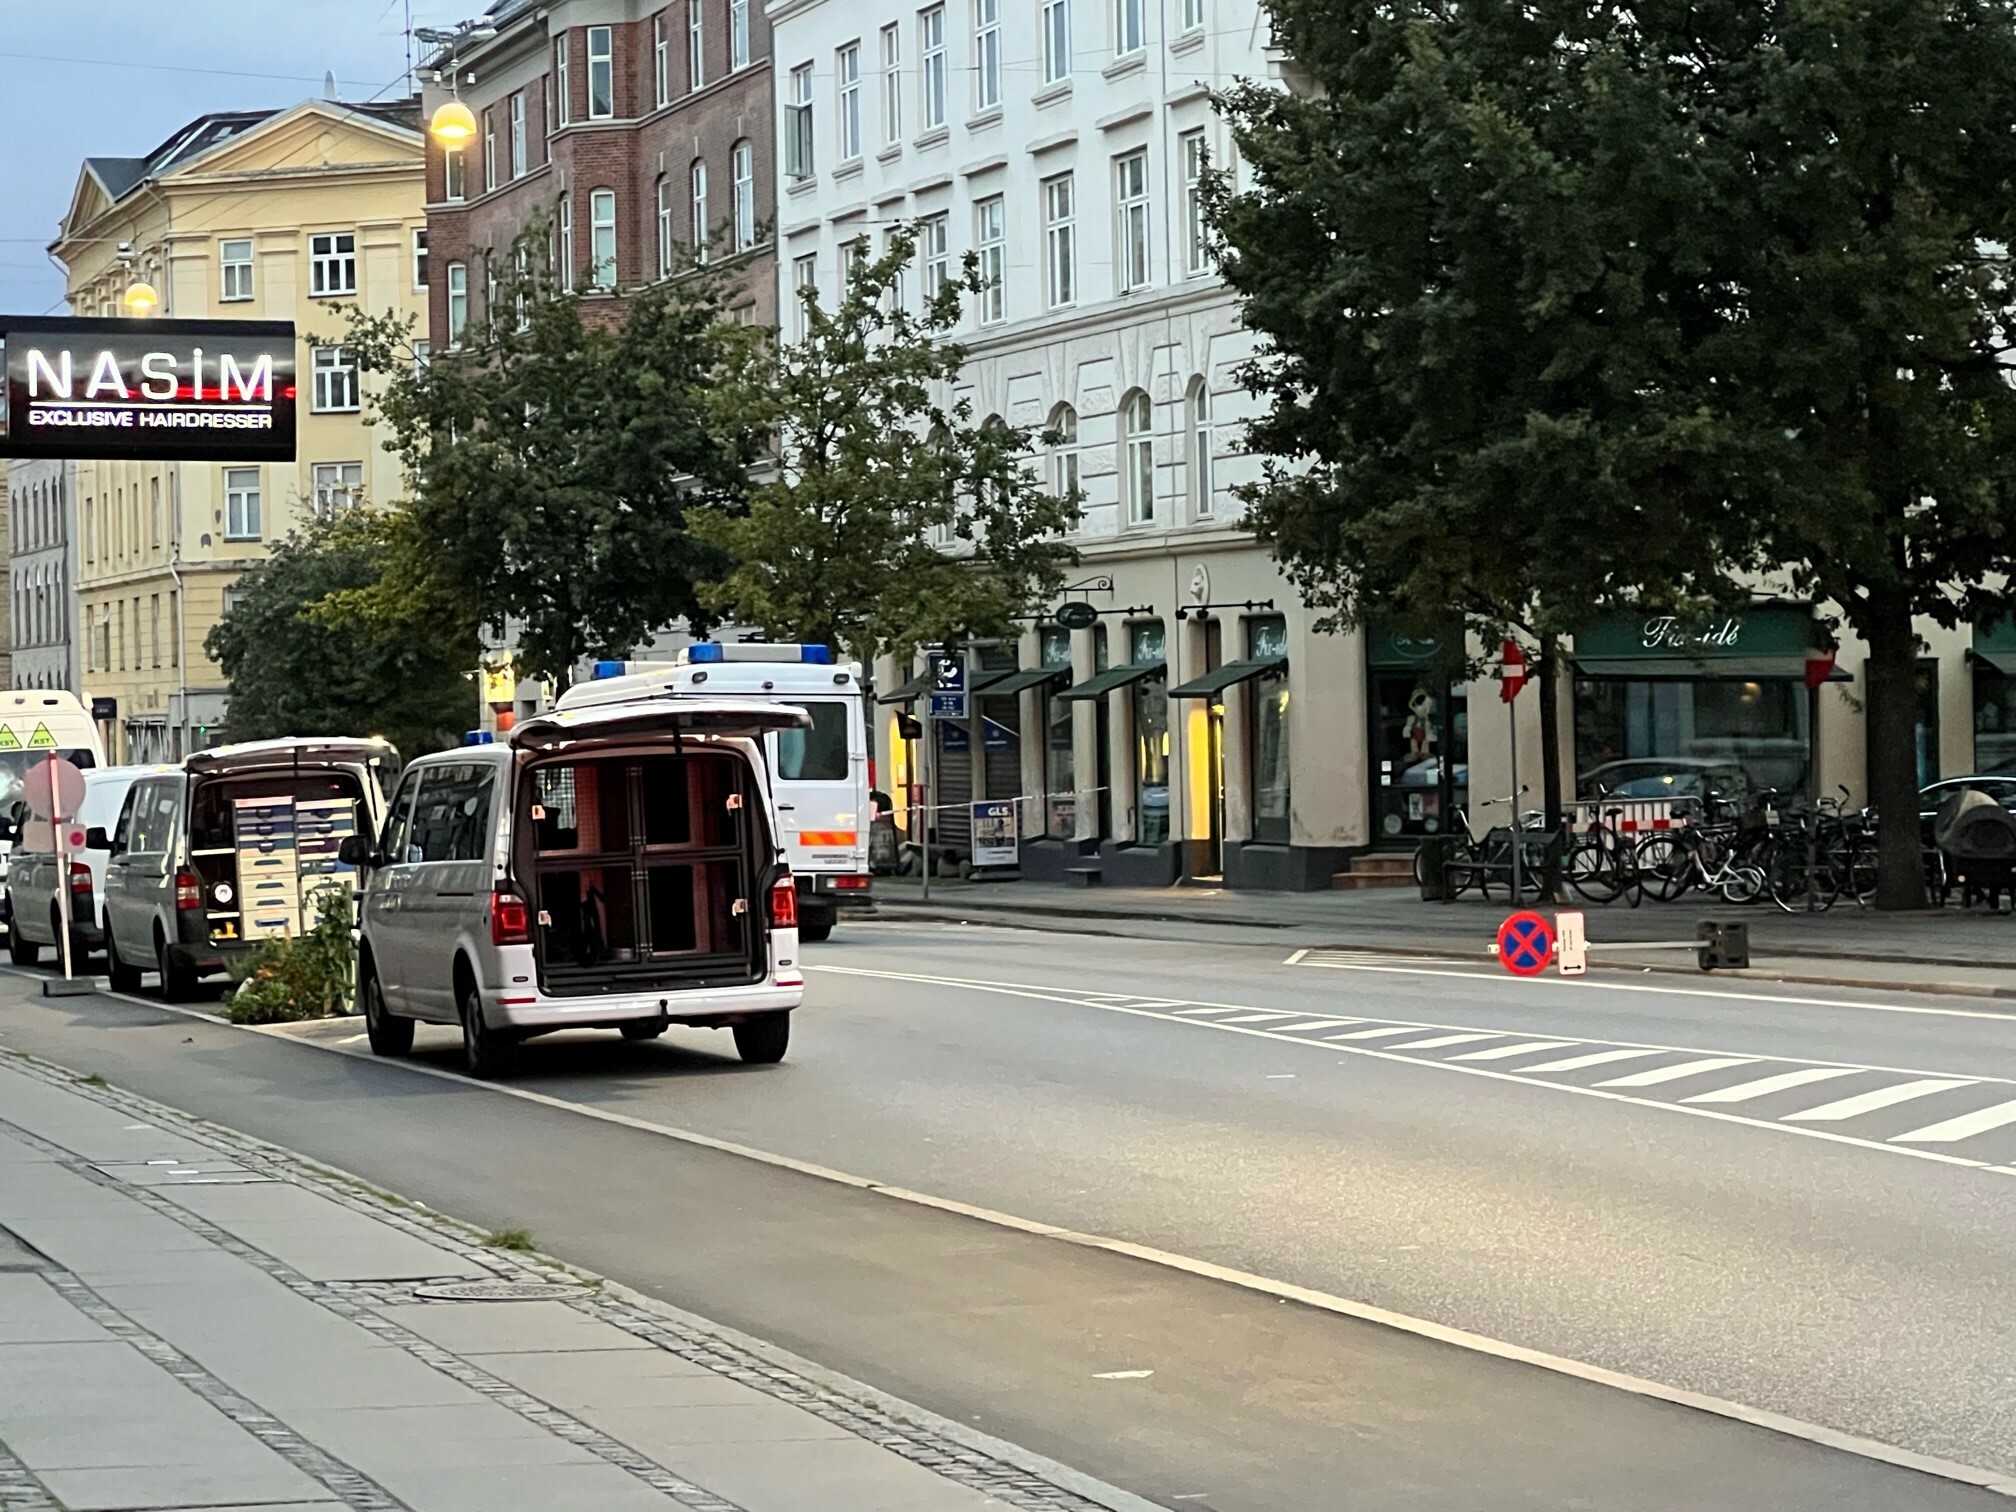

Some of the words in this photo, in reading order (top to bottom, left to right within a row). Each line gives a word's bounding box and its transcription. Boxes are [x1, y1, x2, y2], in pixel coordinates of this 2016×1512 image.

[29, 410, 133, 427] EXCLUSIVE
[139, 412, 272, 429] HAIRDRESSER
[988, 806, 1009, 817] GLS
